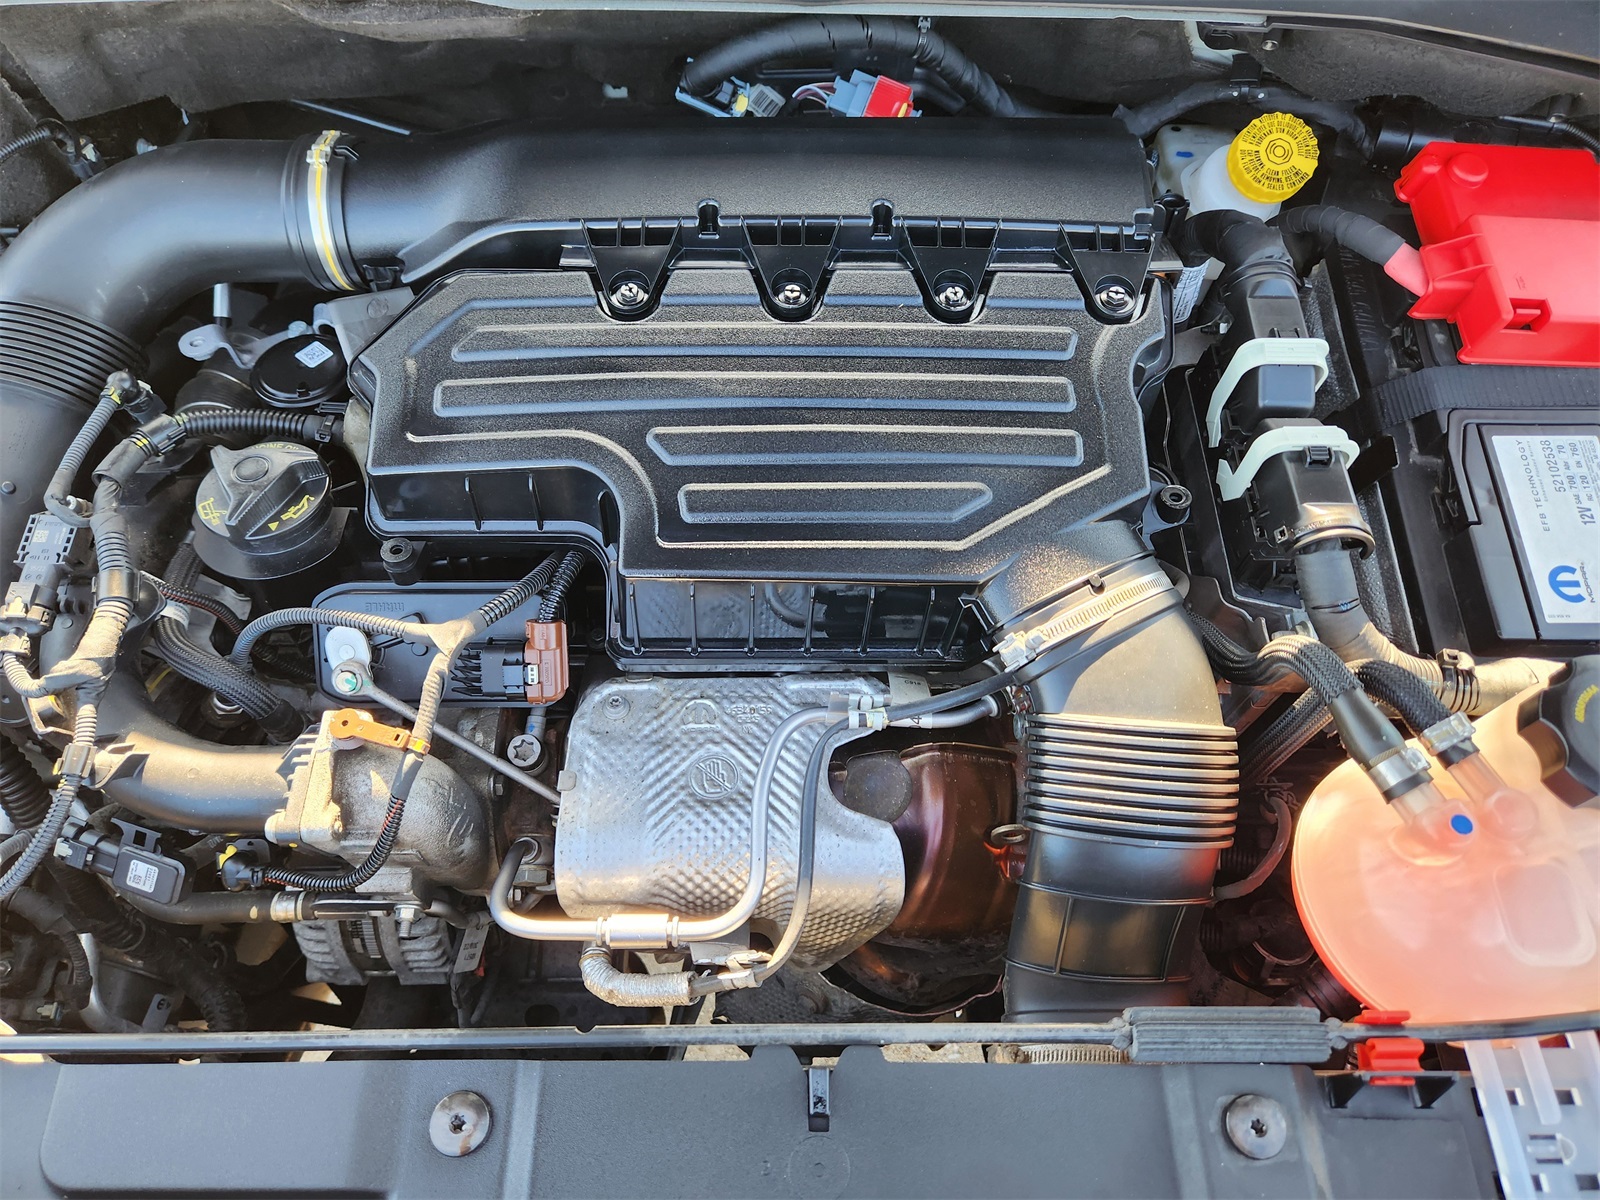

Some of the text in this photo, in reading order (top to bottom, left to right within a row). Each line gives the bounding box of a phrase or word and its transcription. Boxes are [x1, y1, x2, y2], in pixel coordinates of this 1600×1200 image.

[1241, 123, 1257, 142] ATTENTION
[1259, 113, 1279, 123] NETTOYER
[1289, 115, 1306, 129] BOUCHON
[1306, 129, 1316, 142] AVANT
[1254, 127, 1274, 147] PROVENANT
[1286, 129, 1299, 141] BIDON
[1302, 134, 1310, 148] FREIN
[1239, 149, 1247, 160] DOT4
[1241, 161, 1253, 175] FLUID
[1248, 158, 1261, 175] BEFORE
[1293, 168, 1303, 178] ONLY
[1254, 150, 1297, 176] WARNING CLEAN FILLER
[1250, 173, 1262, 185] FROM
[1266, 182, 1285, 190] SEALED
[1286, 171, 1310, 189] CONTAINER
[1556, 444, 1566, 455] 70
[1540, 440, 1566, 493] 52102538
[1515, 440, 1551, 532] EFB TECHNOLOGY
[1566, 475, 1577, 490] 700
[1568, 442, 1596, 525] 12V RC 120 EN 760
[1573, 493, 1582, 505] SAE
